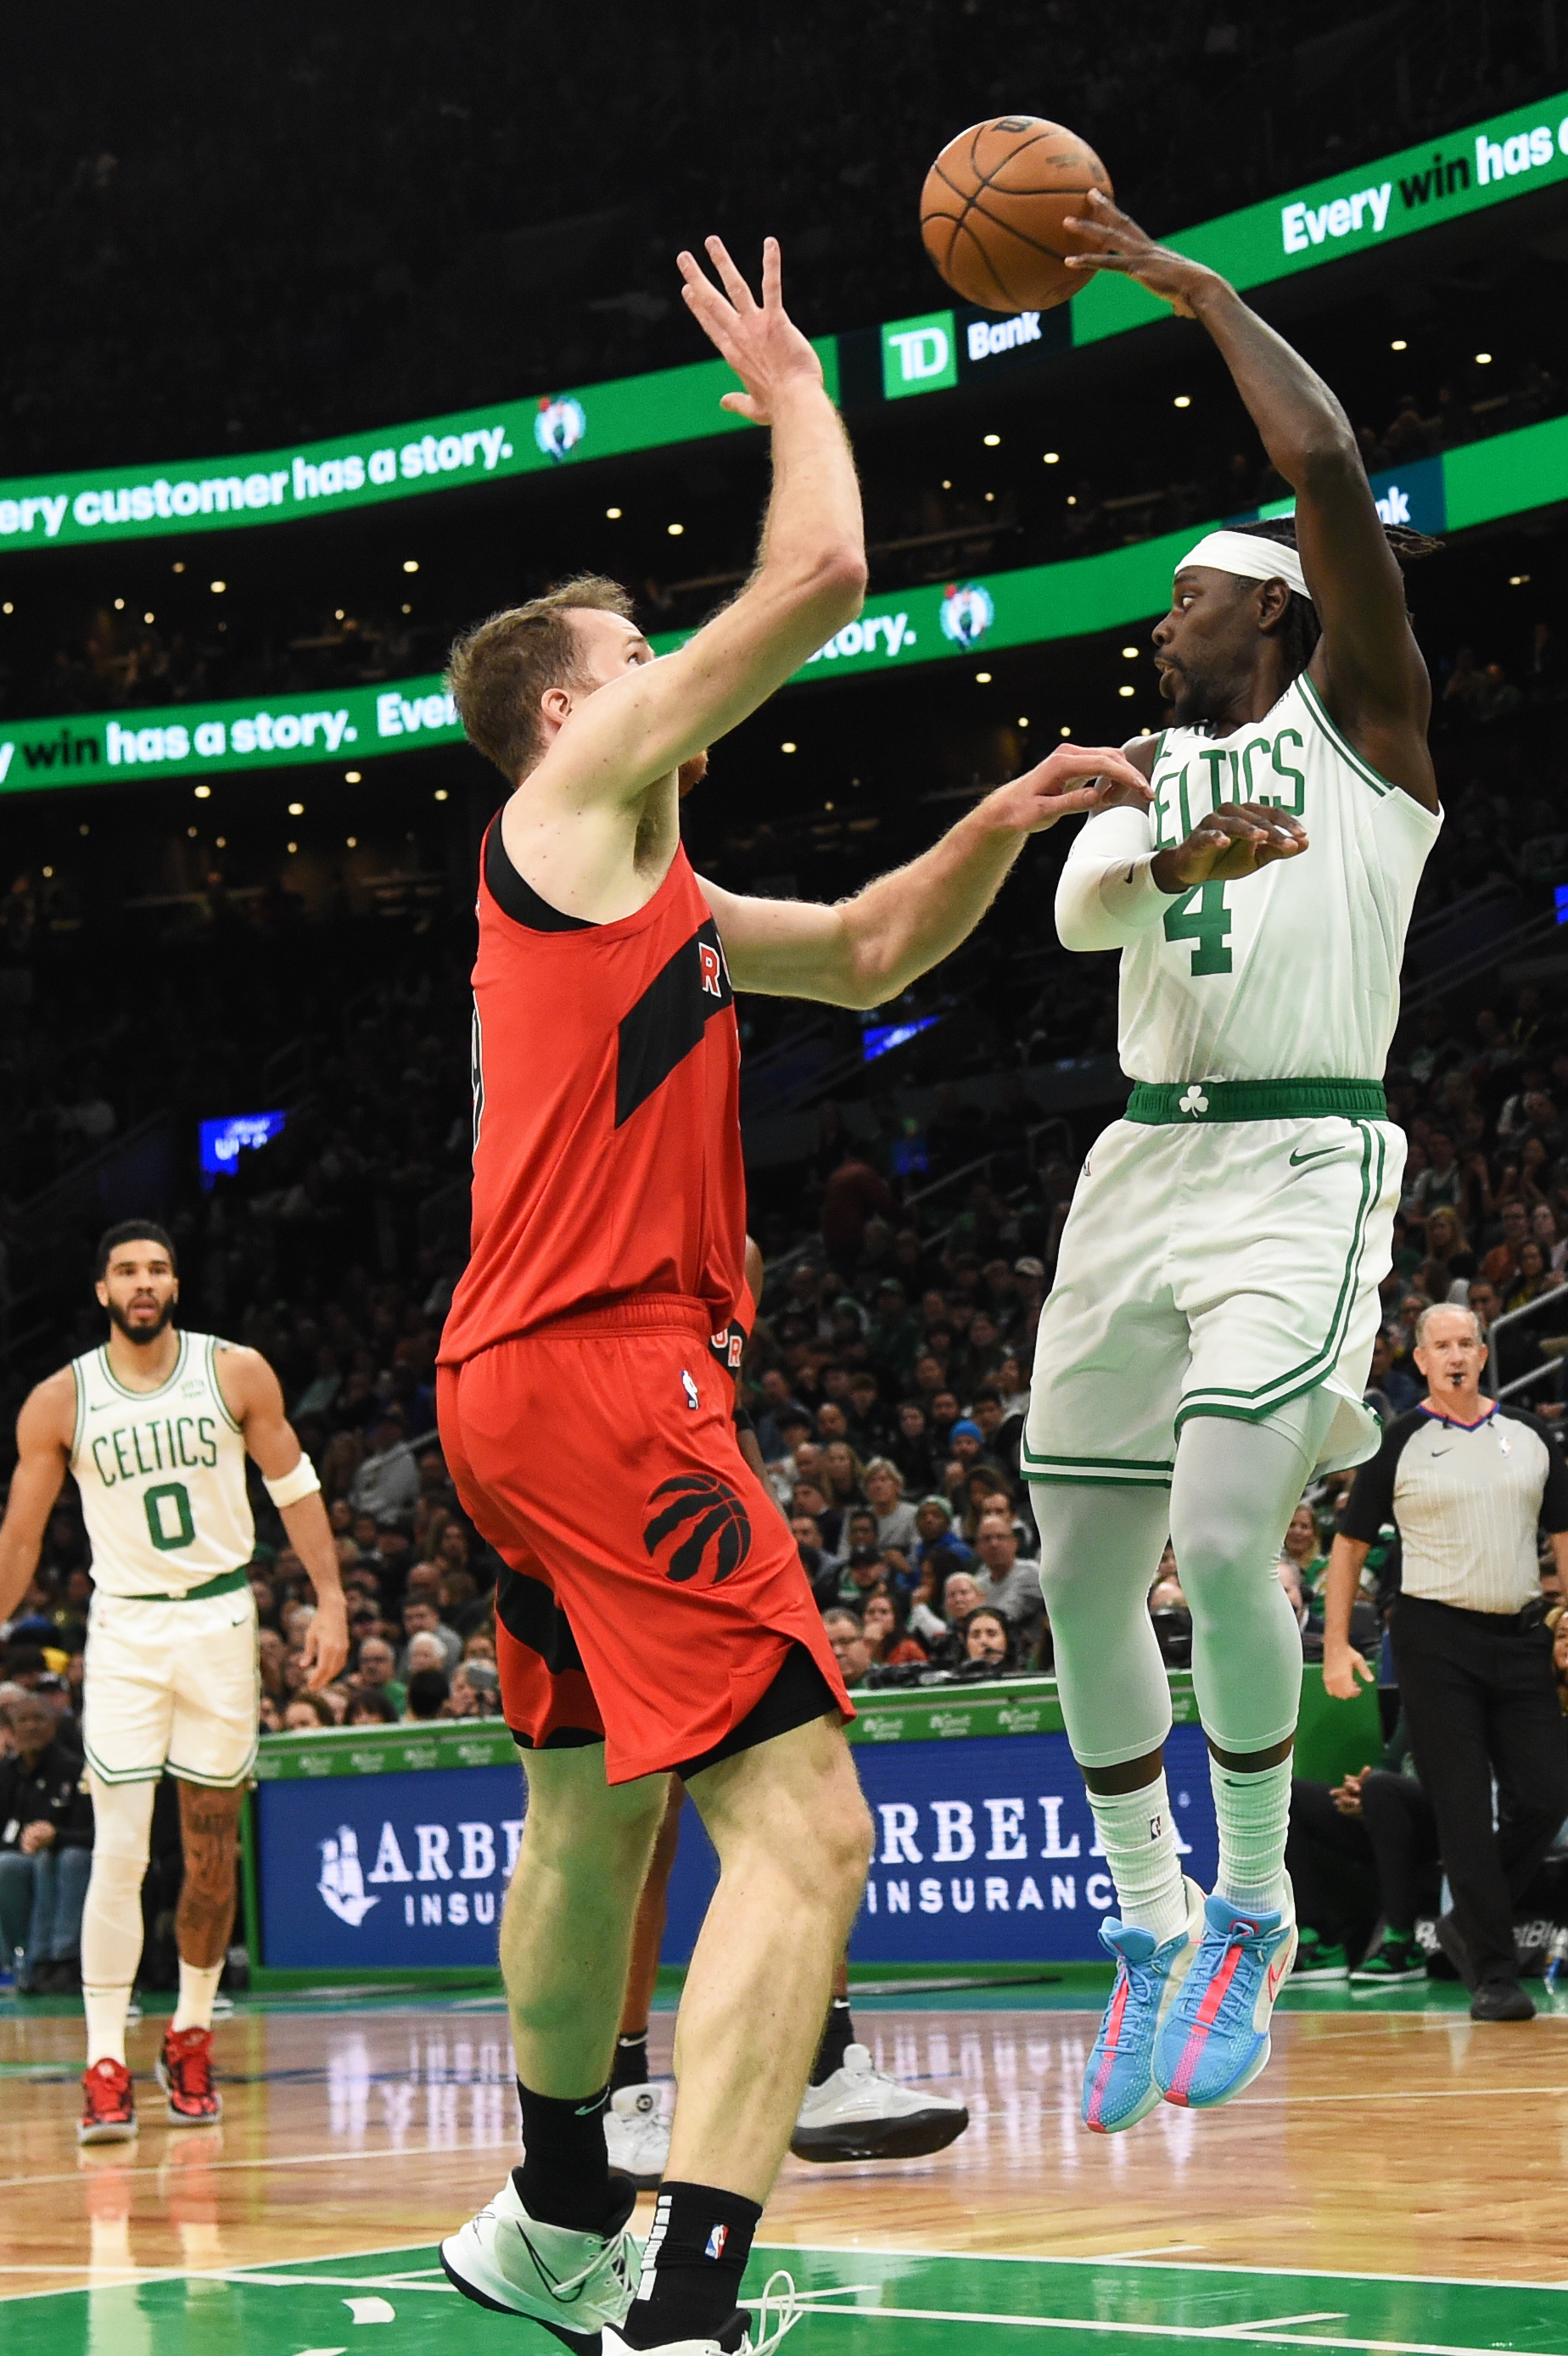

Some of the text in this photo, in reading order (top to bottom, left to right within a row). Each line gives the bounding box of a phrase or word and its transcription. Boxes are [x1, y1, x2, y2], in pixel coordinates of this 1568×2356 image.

[1281, 181, 1392, 254] Every
[1399, 154, 1470, 210] win
[1476, 126, 1554, 186] has
[888, 311, 1042, 381] TD Bank
[0, 426, 513, 537] ery customer has a story.
[23, 729, 99, 771] win
[106, 721, 190, 765] has
[193, 721, 227, 756] a
[230, 709, 357, 753] story.
[1155, 728, 1305, 850] ELTICS
[1162, 880, 1233, 977] 4
[92, 1417, 217, 1487] CELTICS
[143, 1482, 196, 1552] 0
[404, 1891, 499, 1927] INSU
[866, 1872, 1112, 1914] INSURANC
